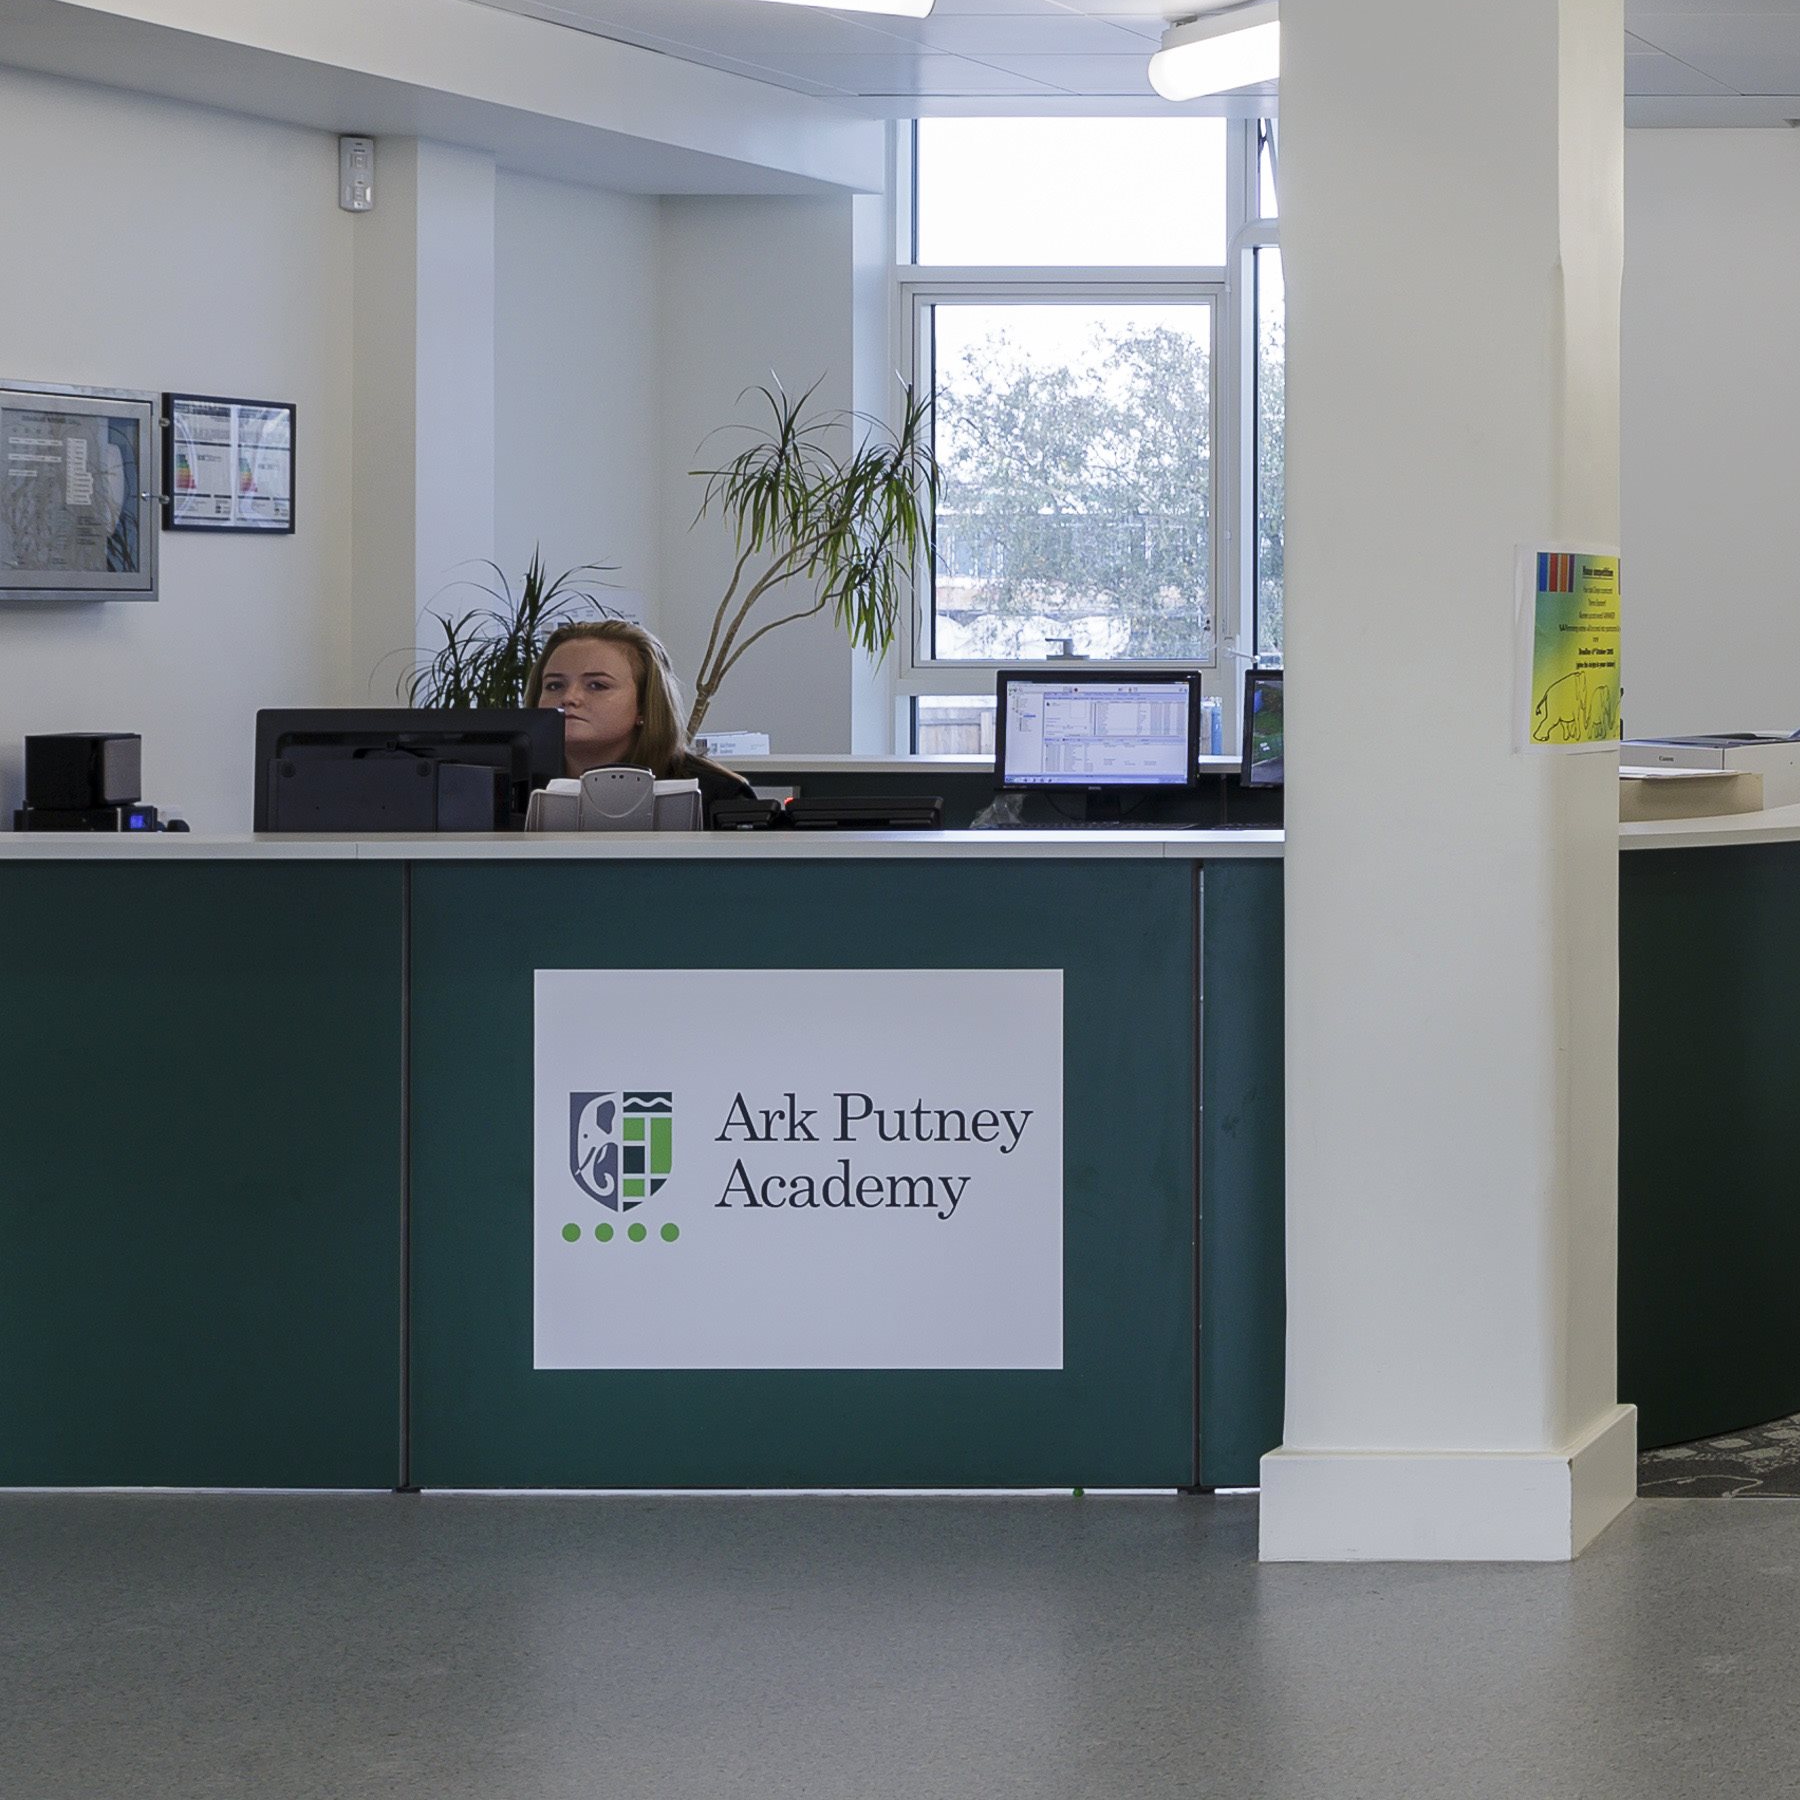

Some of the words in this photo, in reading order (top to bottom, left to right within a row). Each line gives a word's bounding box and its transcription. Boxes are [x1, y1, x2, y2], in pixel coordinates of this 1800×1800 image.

[714, 1092, 820, 1143] Ark
[832, 1092, 1034, 1154] Putney
[714, 1158, 971, 1220] Academy
